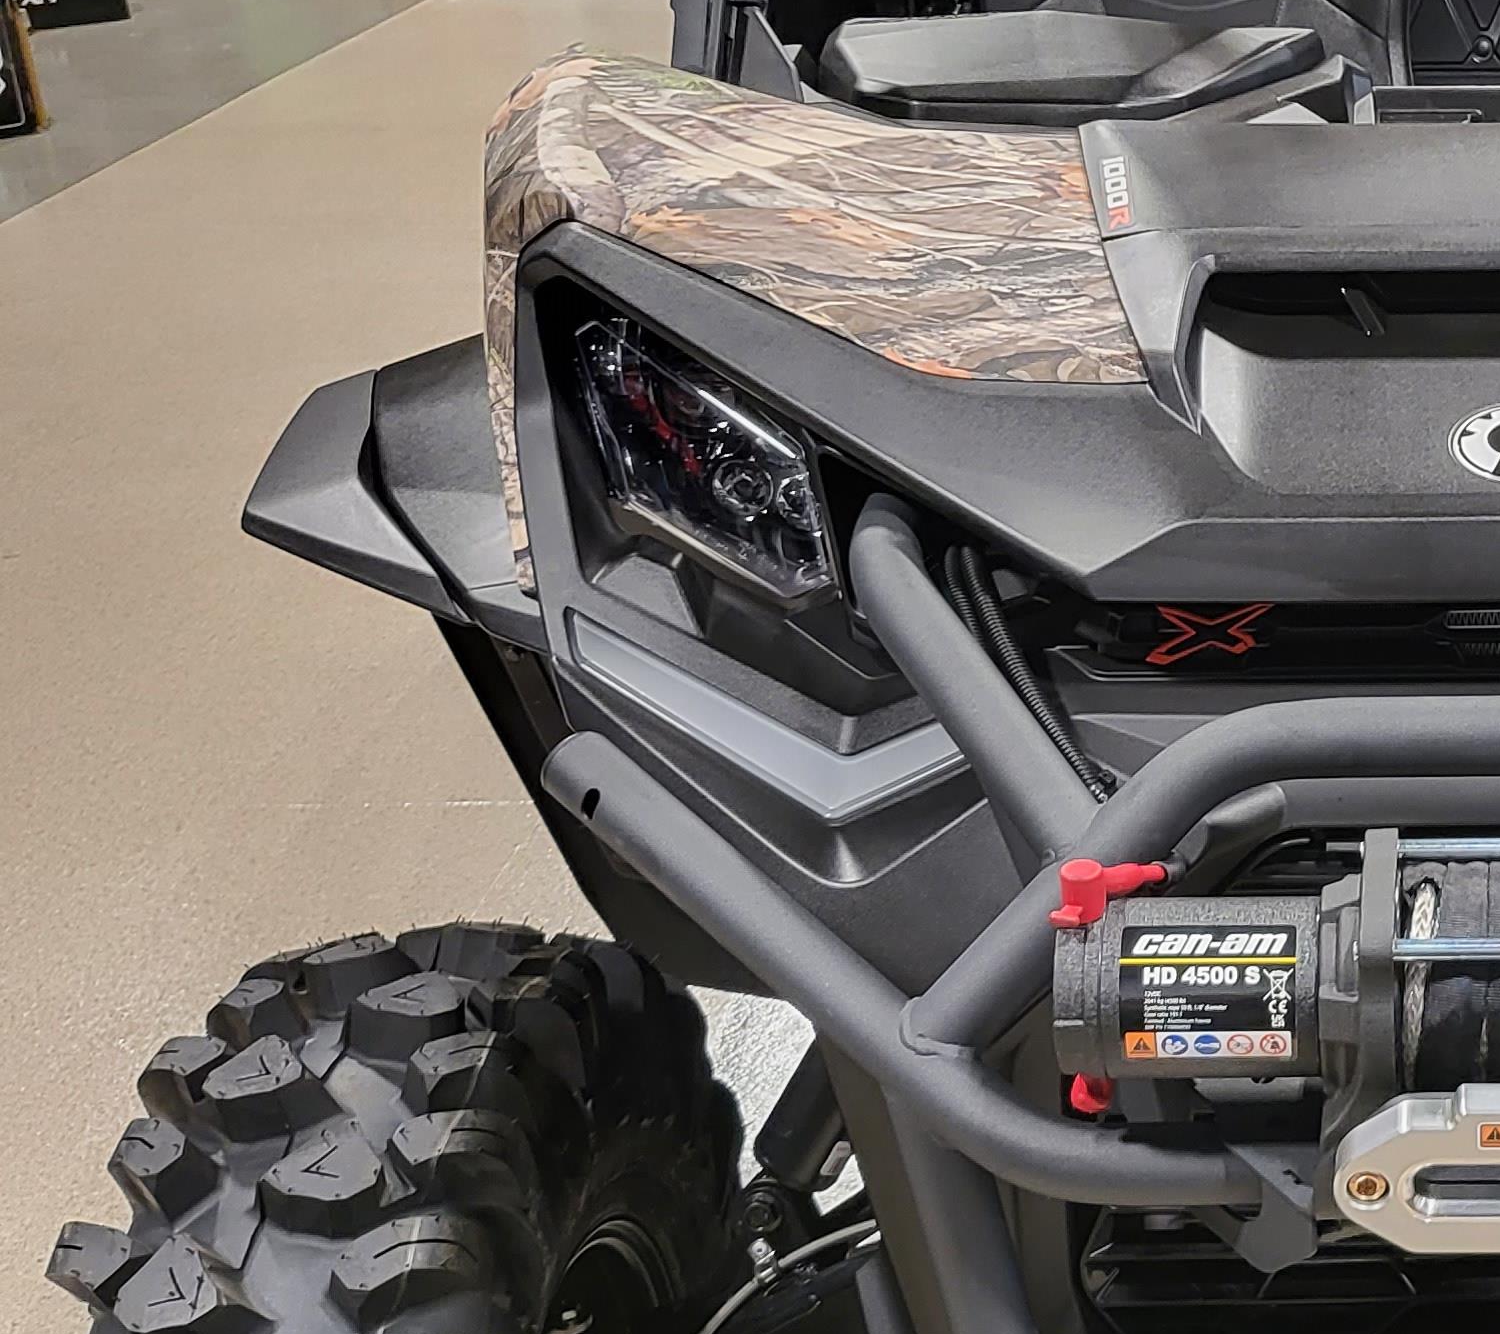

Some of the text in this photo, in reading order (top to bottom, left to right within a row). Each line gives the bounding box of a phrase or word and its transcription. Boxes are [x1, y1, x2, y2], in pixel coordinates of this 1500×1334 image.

[1101, 155, 1132, 231] 1000R
[1132, 932, 1289, 956] can-am
[1142, 965, 1262, 986] HD 4500 S
